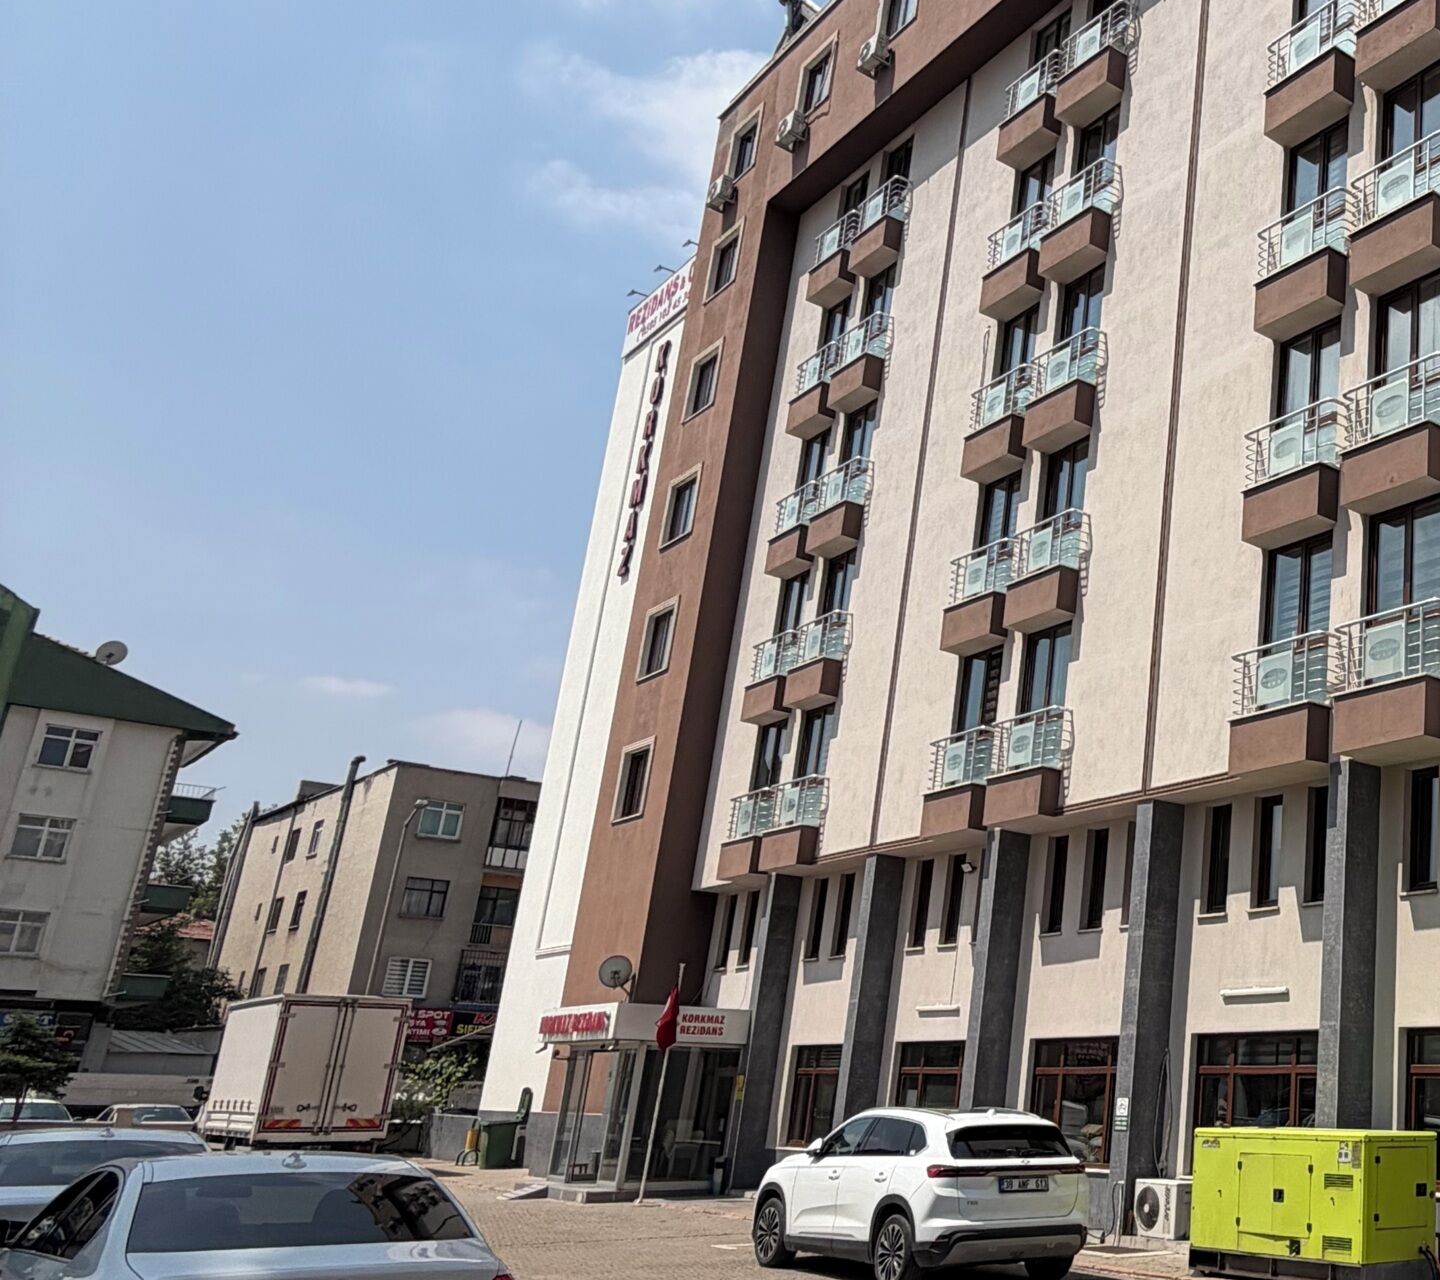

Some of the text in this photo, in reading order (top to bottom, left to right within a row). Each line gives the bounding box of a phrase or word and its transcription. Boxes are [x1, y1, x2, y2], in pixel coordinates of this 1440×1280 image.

[617, 339, 672, 577] KORKMAZ
[416, 1009, 451, 1020] SPOT
[682, 1013, 726, 1025] KORKMAZ
